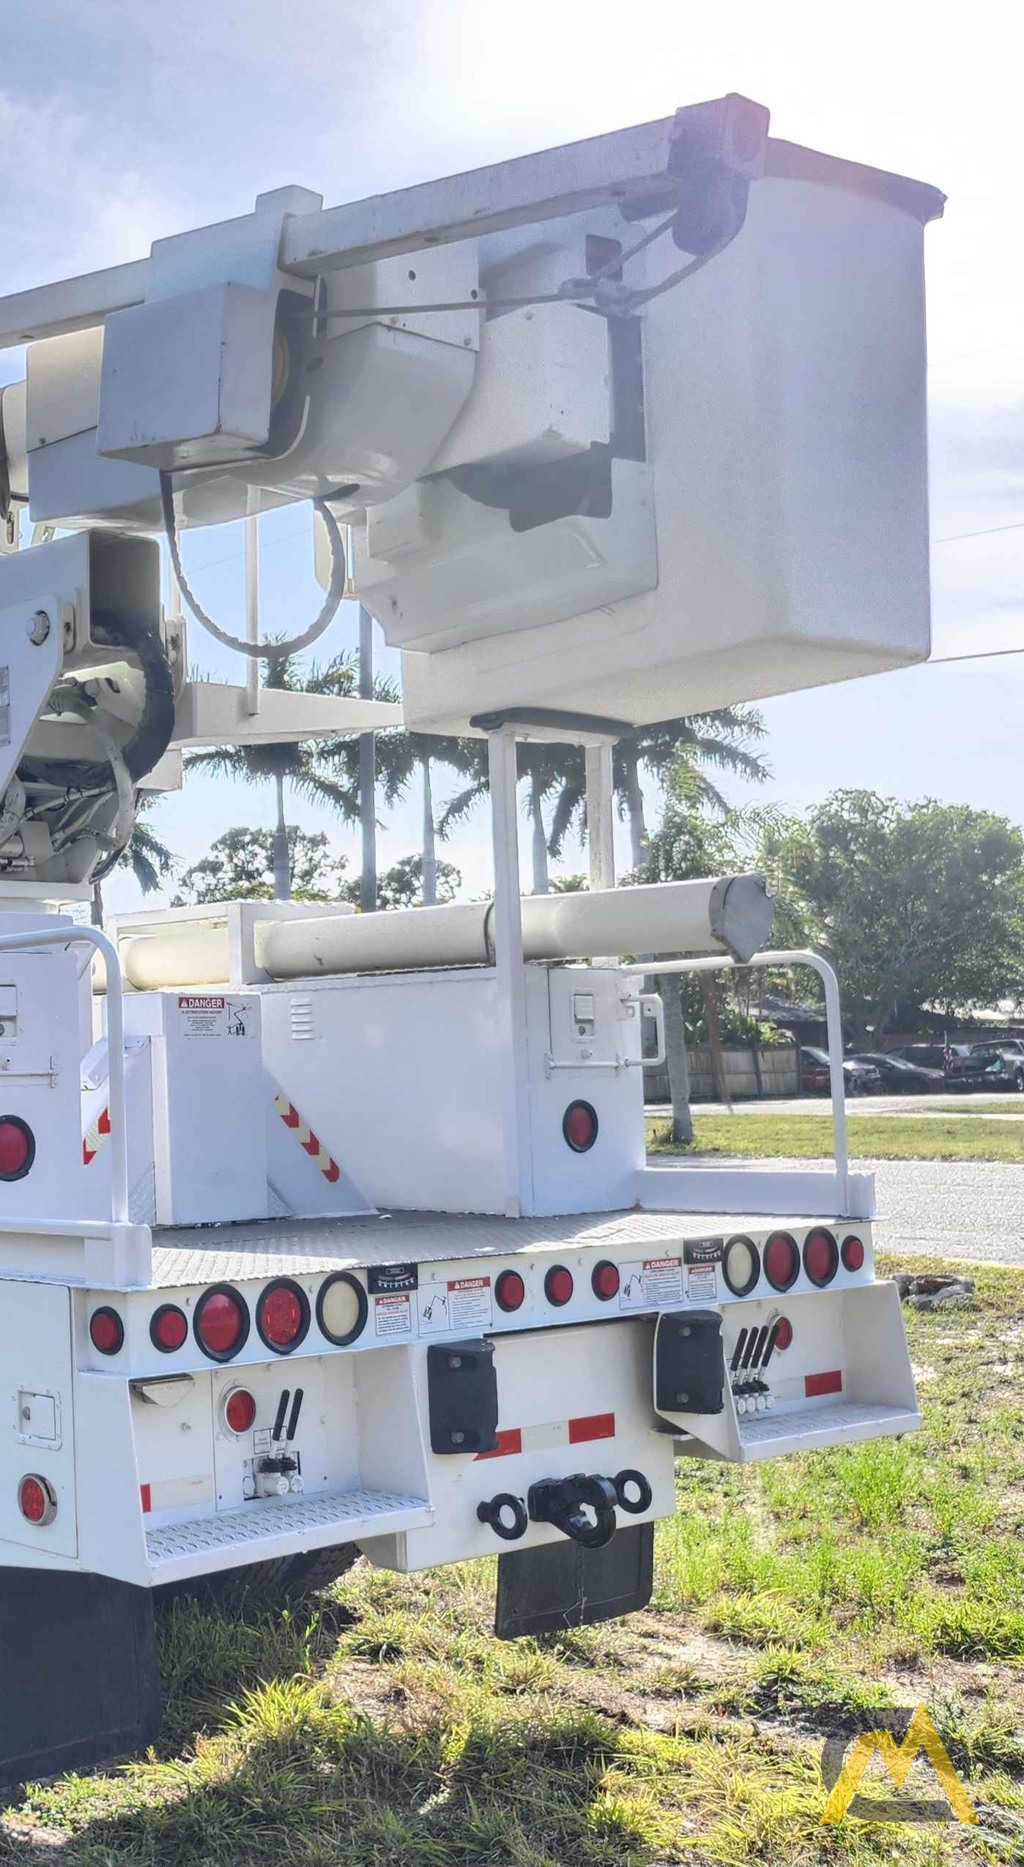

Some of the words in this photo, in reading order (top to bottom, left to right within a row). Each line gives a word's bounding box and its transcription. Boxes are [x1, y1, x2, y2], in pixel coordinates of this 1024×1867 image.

[188, 999, 223, 1008] DANGER
[651, 1259, 679, 1269] DANGER
[460, 1280, 484, 1289] DANGER
[382, 1296, 406, 1304] DANGER
